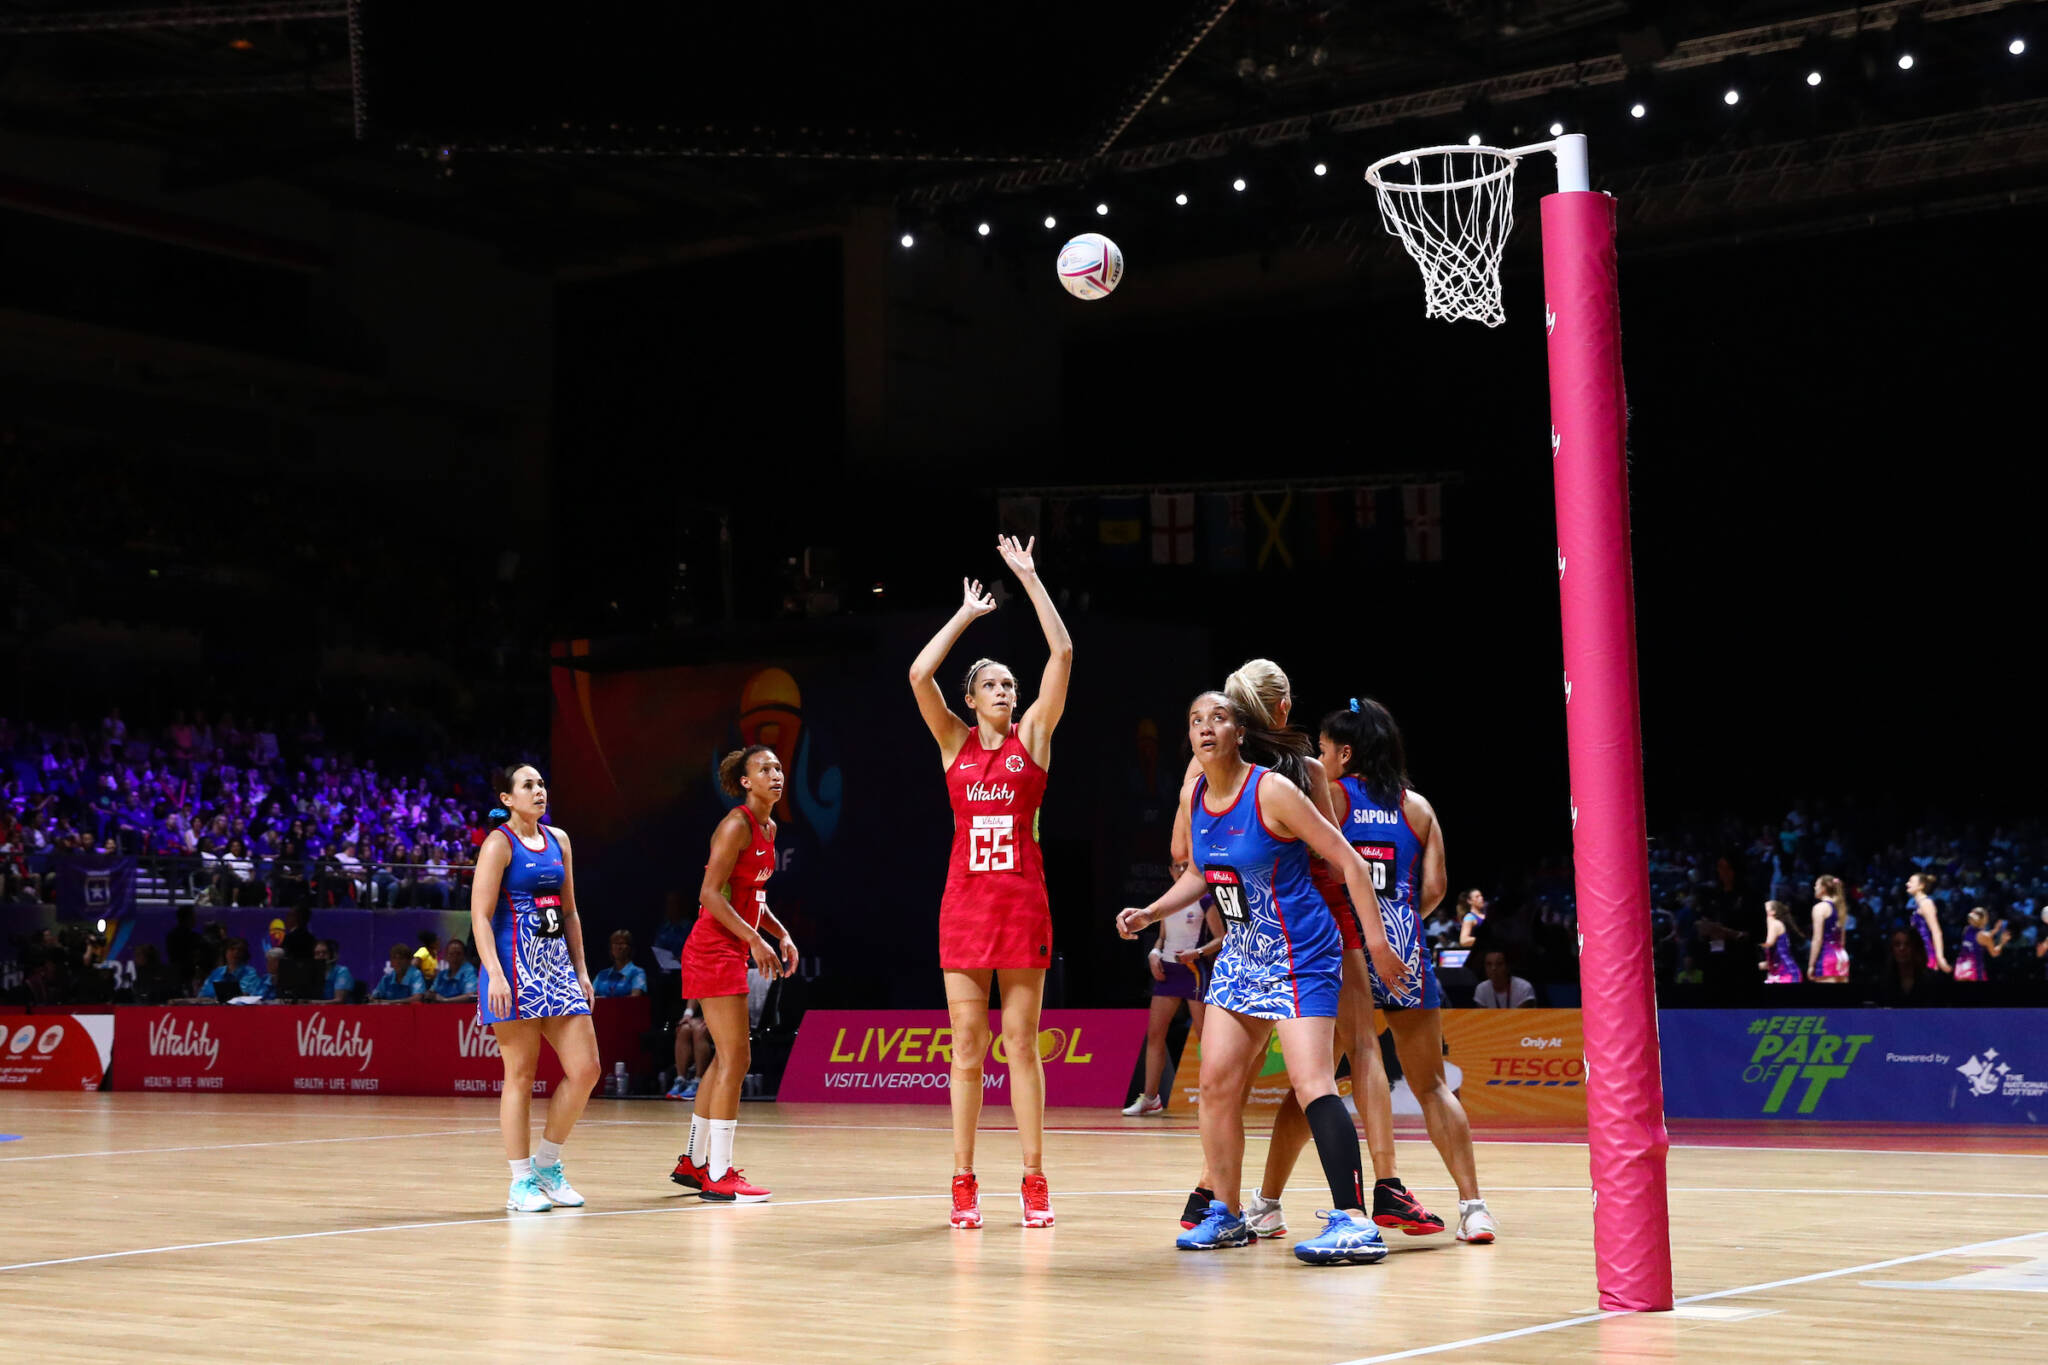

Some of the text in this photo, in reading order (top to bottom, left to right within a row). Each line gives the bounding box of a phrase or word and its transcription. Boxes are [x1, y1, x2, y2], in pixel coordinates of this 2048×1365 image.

[966, 780, 1015, 806] Vitality
[969, 828, 1014, 871] GS
[1372, 861, 1386, 890] D
[545, 907, 560, 933] C
[458, 1015, 502, 1058] Vita
[1747, 1016, 1827, 1034] #FEEL
[149, 1012, 219, 1070] Vitality
[296, 1011, 373, 1071] Vitality
[829, 1027, 1093, 1063] LIVEROL
[1520, 1037, 1562, 1049] Only At
[1750, 1035, 1874, 1064] PART
[1489, 1058, 1585, 1077] TESCO
[1886, 1053, 1950, 1064] Powered by
[143, 1076, 224, 1088] HEALTH LIFE INVEST
[293, 1077, 379, 1090] HEALTH LIFE INVEST
[454, 1079, 548, 1093] HEALTH LIF EST
[824, 1073, 1005, 1088] VISITLIVERPOOM
[1742, 1064, 1849, 1114] OF IT
